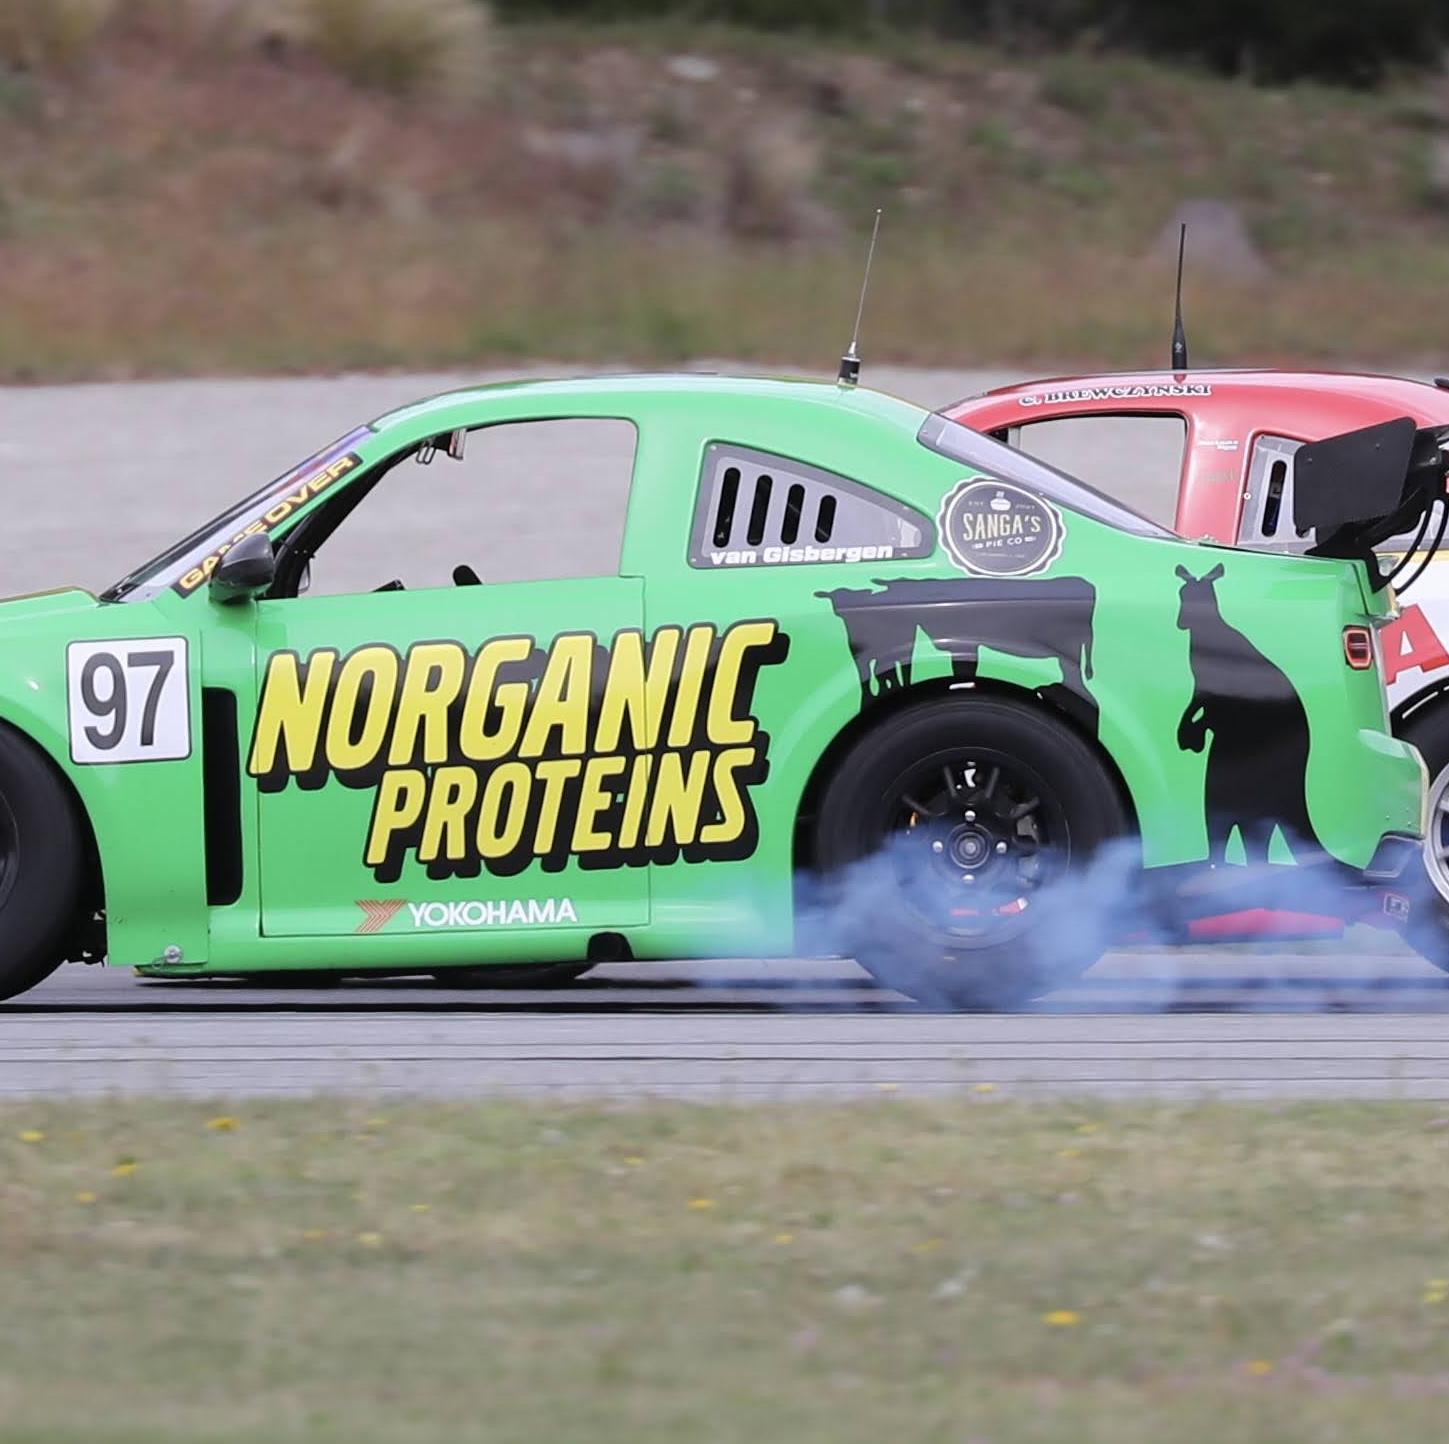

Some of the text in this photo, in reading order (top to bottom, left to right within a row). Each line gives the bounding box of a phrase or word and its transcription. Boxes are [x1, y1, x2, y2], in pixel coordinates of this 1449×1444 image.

[1045, 385, 1212, 404] BREWCZYNSKI
[264, 456, 354, 524] OVER
[963, 513, 1041, 541] SANGA'S
[1007, 537, 1022, 545] CO
[710, 545, 893, 564] van Gisbergen
[79, 650, 176, 750] 97
[248, 620, 776, 776] NORGANIC
[367, 747, 755, 866] PROTEINS
[408, 898, 577, 927] YOKOHAMA
